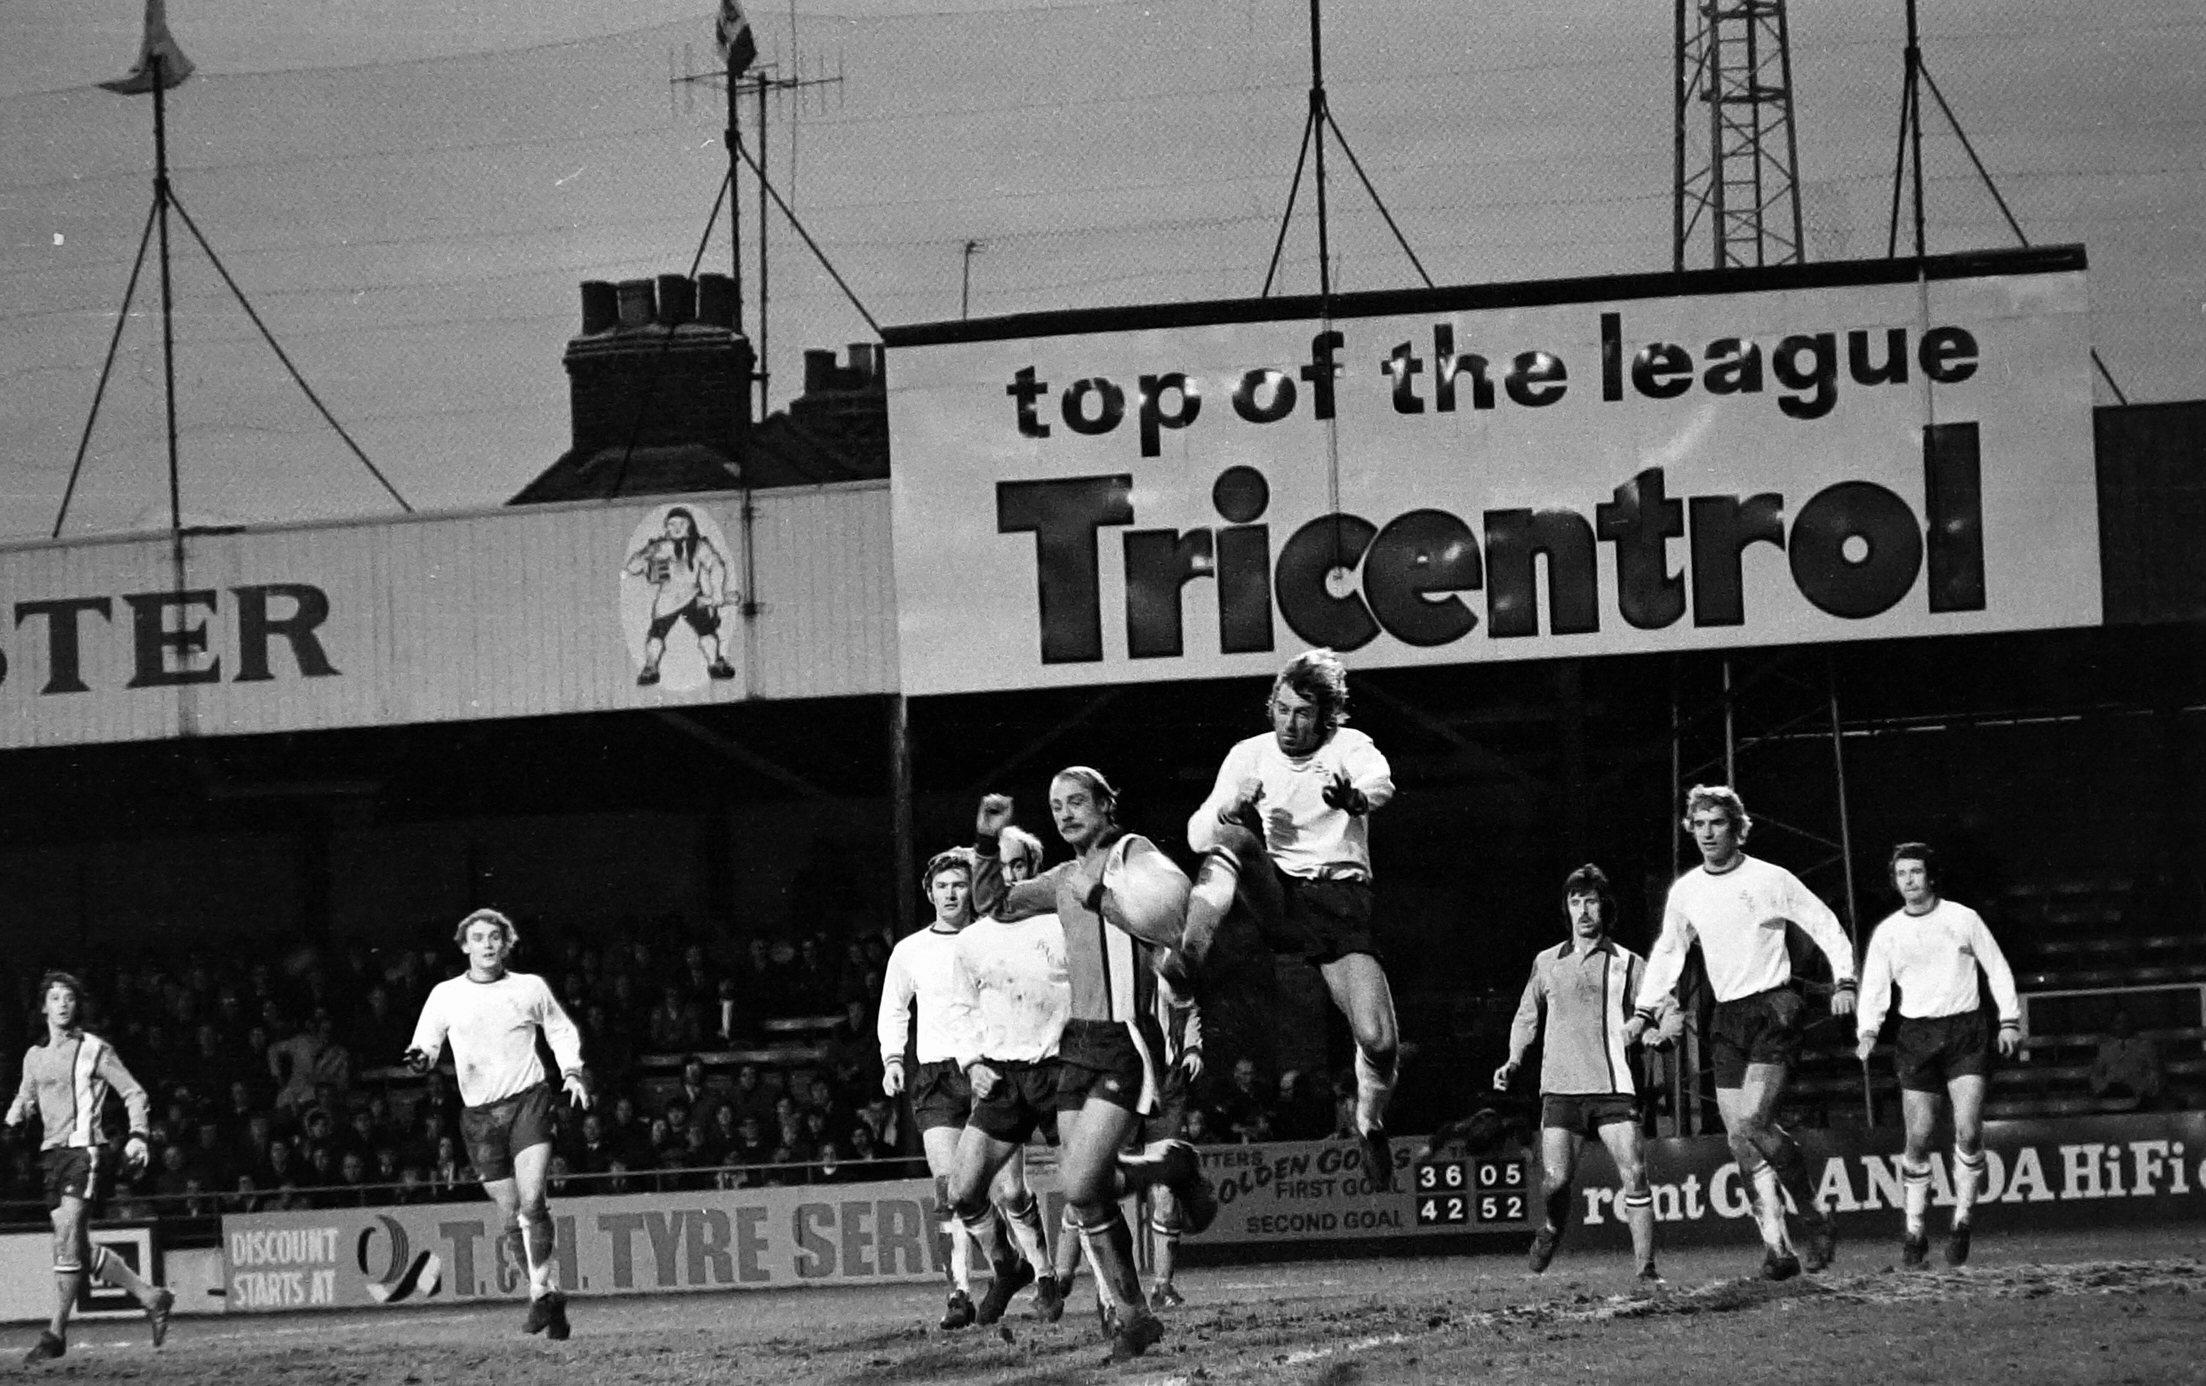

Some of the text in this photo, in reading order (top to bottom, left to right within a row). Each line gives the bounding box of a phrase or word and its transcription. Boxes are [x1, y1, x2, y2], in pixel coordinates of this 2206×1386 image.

[1007, 312, 1981, 456] top of the league
[997, 421, 1987, 664] Tricentrol
[0, 583, 343, 696] TER
[1200, 1148, 1411, 1204] OLDEN GOS
[1276, 1179, 1338, 1200] FIRST
[1343, 1178, 1406, 1196] GOL
[1710, 1146, 2056, 1218] GANADA
[231, 1227, 339, 1266] DISCOUNT
[598, 1206, 771, 1288] TYRE
[1247, 1212, 1338, 1234] SECOND
[1343, 1210, 1404, 1230] GOAL
[233, 1269, 336, 1307] STARTS AT
